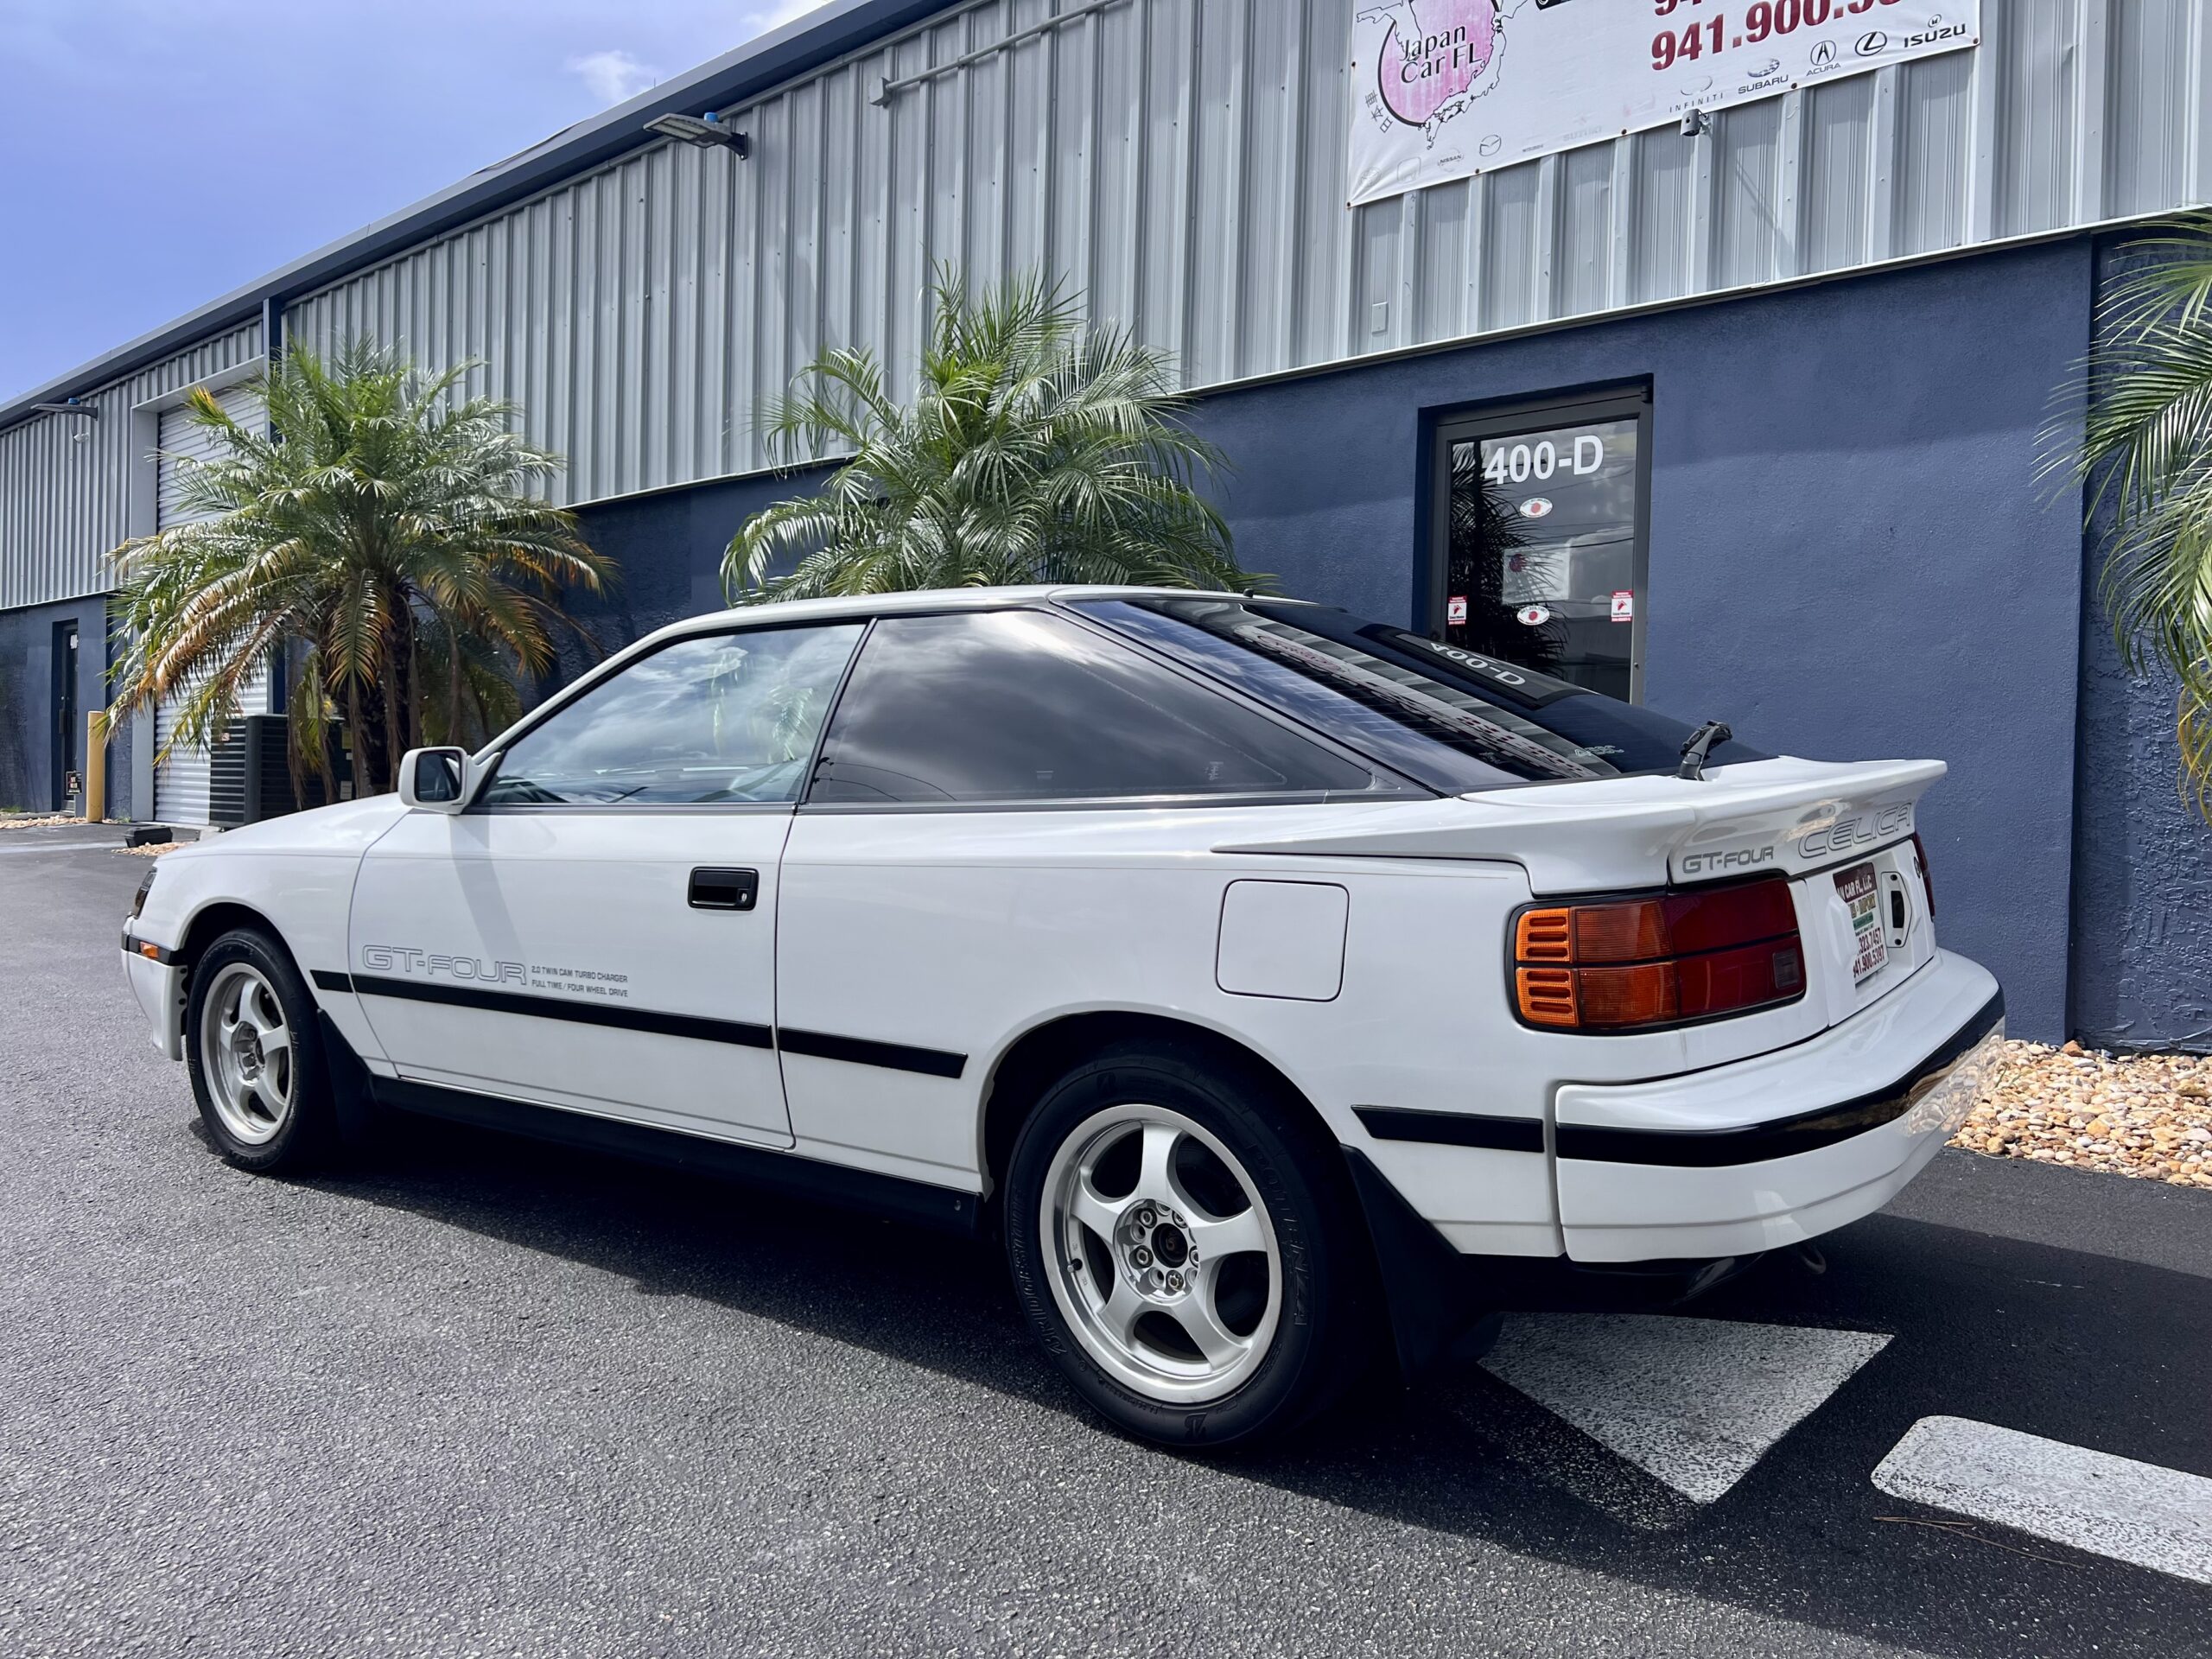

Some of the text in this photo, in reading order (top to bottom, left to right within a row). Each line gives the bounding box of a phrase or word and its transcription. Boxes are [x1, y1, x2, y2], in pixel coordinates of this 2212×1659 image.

[1399, 25, 1465, 61] Japan
[1651, 0, 1902, 71] 941.900.
[1904, 23, 1967, 48] ISUZU
[1401, 42, 1483, 83] Car FL
[1806, 62, 1841, 77] ACURA
[1738, 74, 1789, 94] SUBARU
[1669, 92, 1724, 113] INFINITI
[1484, 435, 1604, 485] 400-D
[1797, 802, 1913, 859] CELICA
[1681, 846, 1774, 874] GT-FOUR
[362, 944, 527, 986] GT-FOUR
[542, 966, 558, 976] TWIN
[559, 968, 574, 977] CAM
[575, 969, 596, 980] TURBO
[596, 972, 628, 983] CHARGER
[531, 979, 546, 988] FULL
[547, 981, 563, 990] TIME
[567, 982, 585, 993] FOUR
[586, 985, 607, 995] WHEEL
[608, 988, 629, 998] DRIVE
